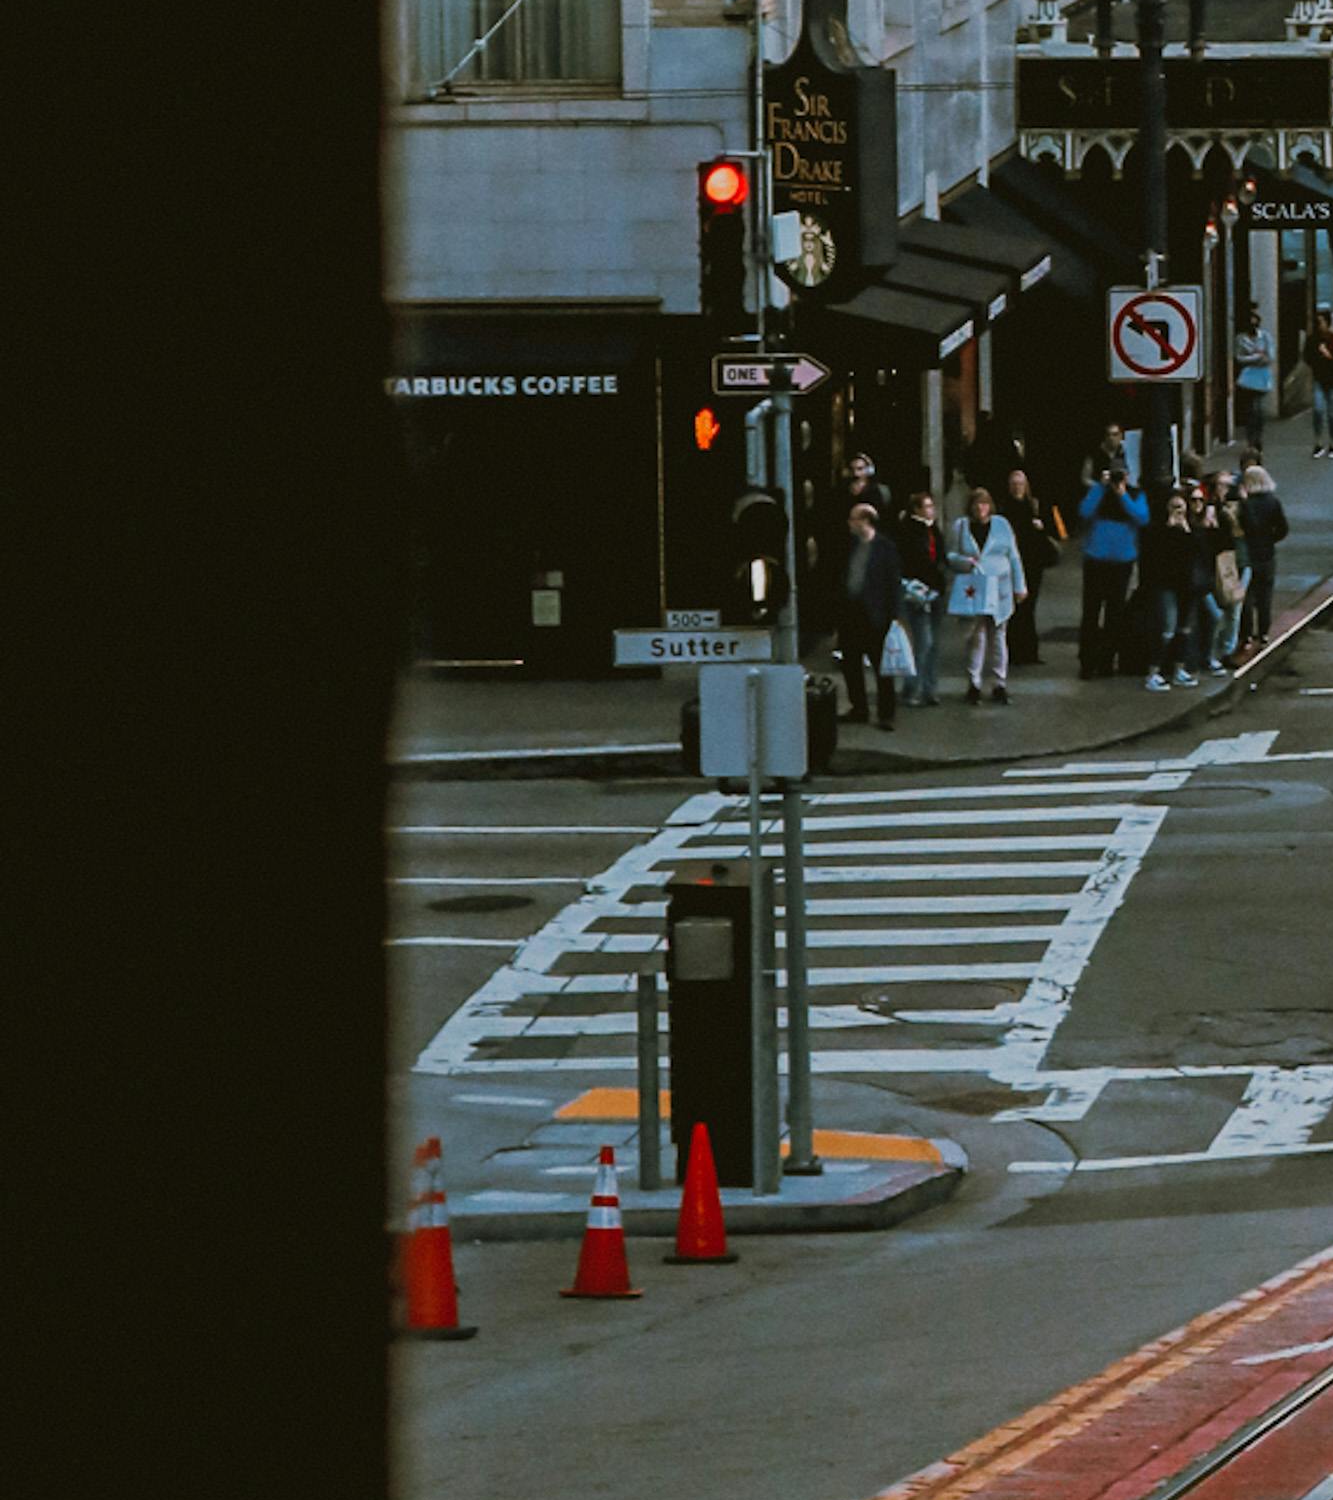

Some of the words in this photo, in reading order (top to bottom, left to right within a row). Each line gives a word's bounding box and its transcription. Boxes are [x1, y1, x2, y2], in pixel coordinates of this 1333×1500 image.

[1251, 202, 1331, 220] SCALA'S
[726, 367, 758, 382] ONE
[521, 375, 618, 395] COFFEE
[651, 637, 740, 657] Sutter
